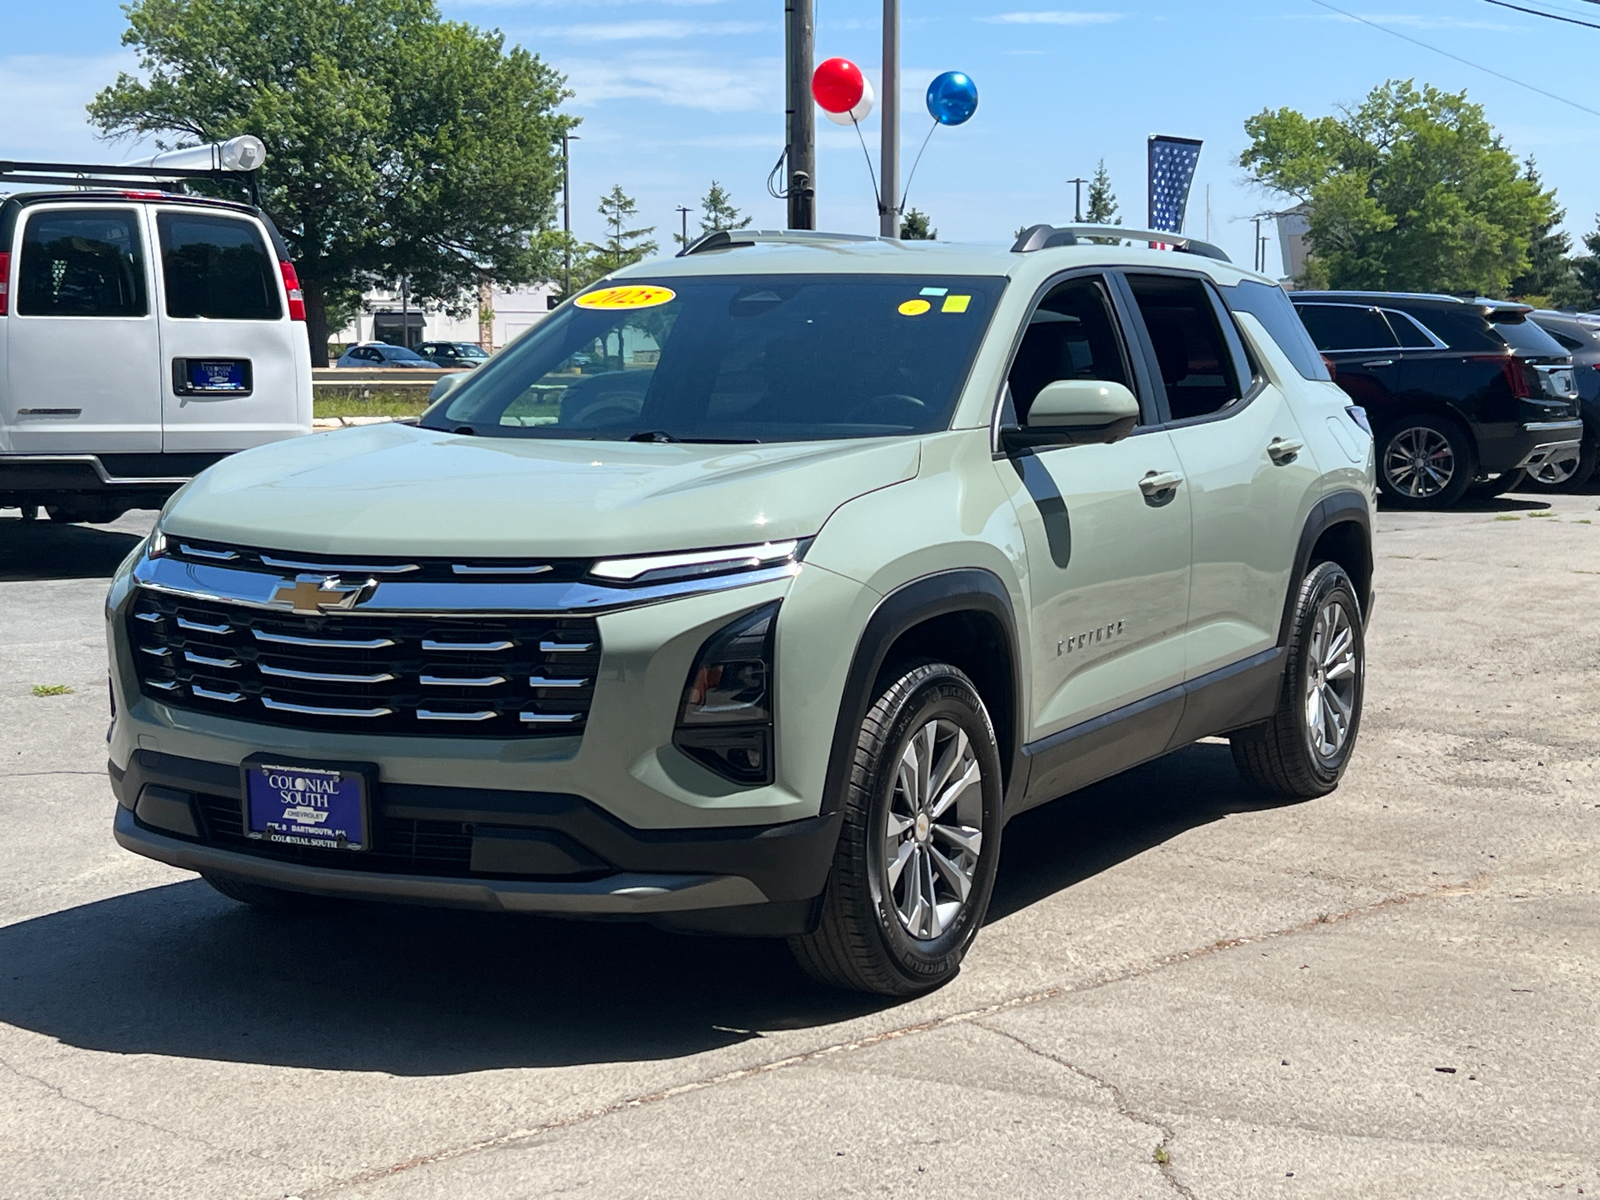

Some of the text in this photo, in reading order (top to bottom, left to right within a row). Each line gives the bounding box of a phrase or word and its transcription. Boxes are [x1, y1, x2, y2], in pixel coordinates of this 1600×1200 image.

[586, 290, 663, 304] 2025
[269, 775, 340, 794] COLONIAL
[281, 791, 329, 807] SOUTH
[287, 810, 323, 819] CHEVROLET
[271, 834, 337, 848] COLONIAL SOUTH
